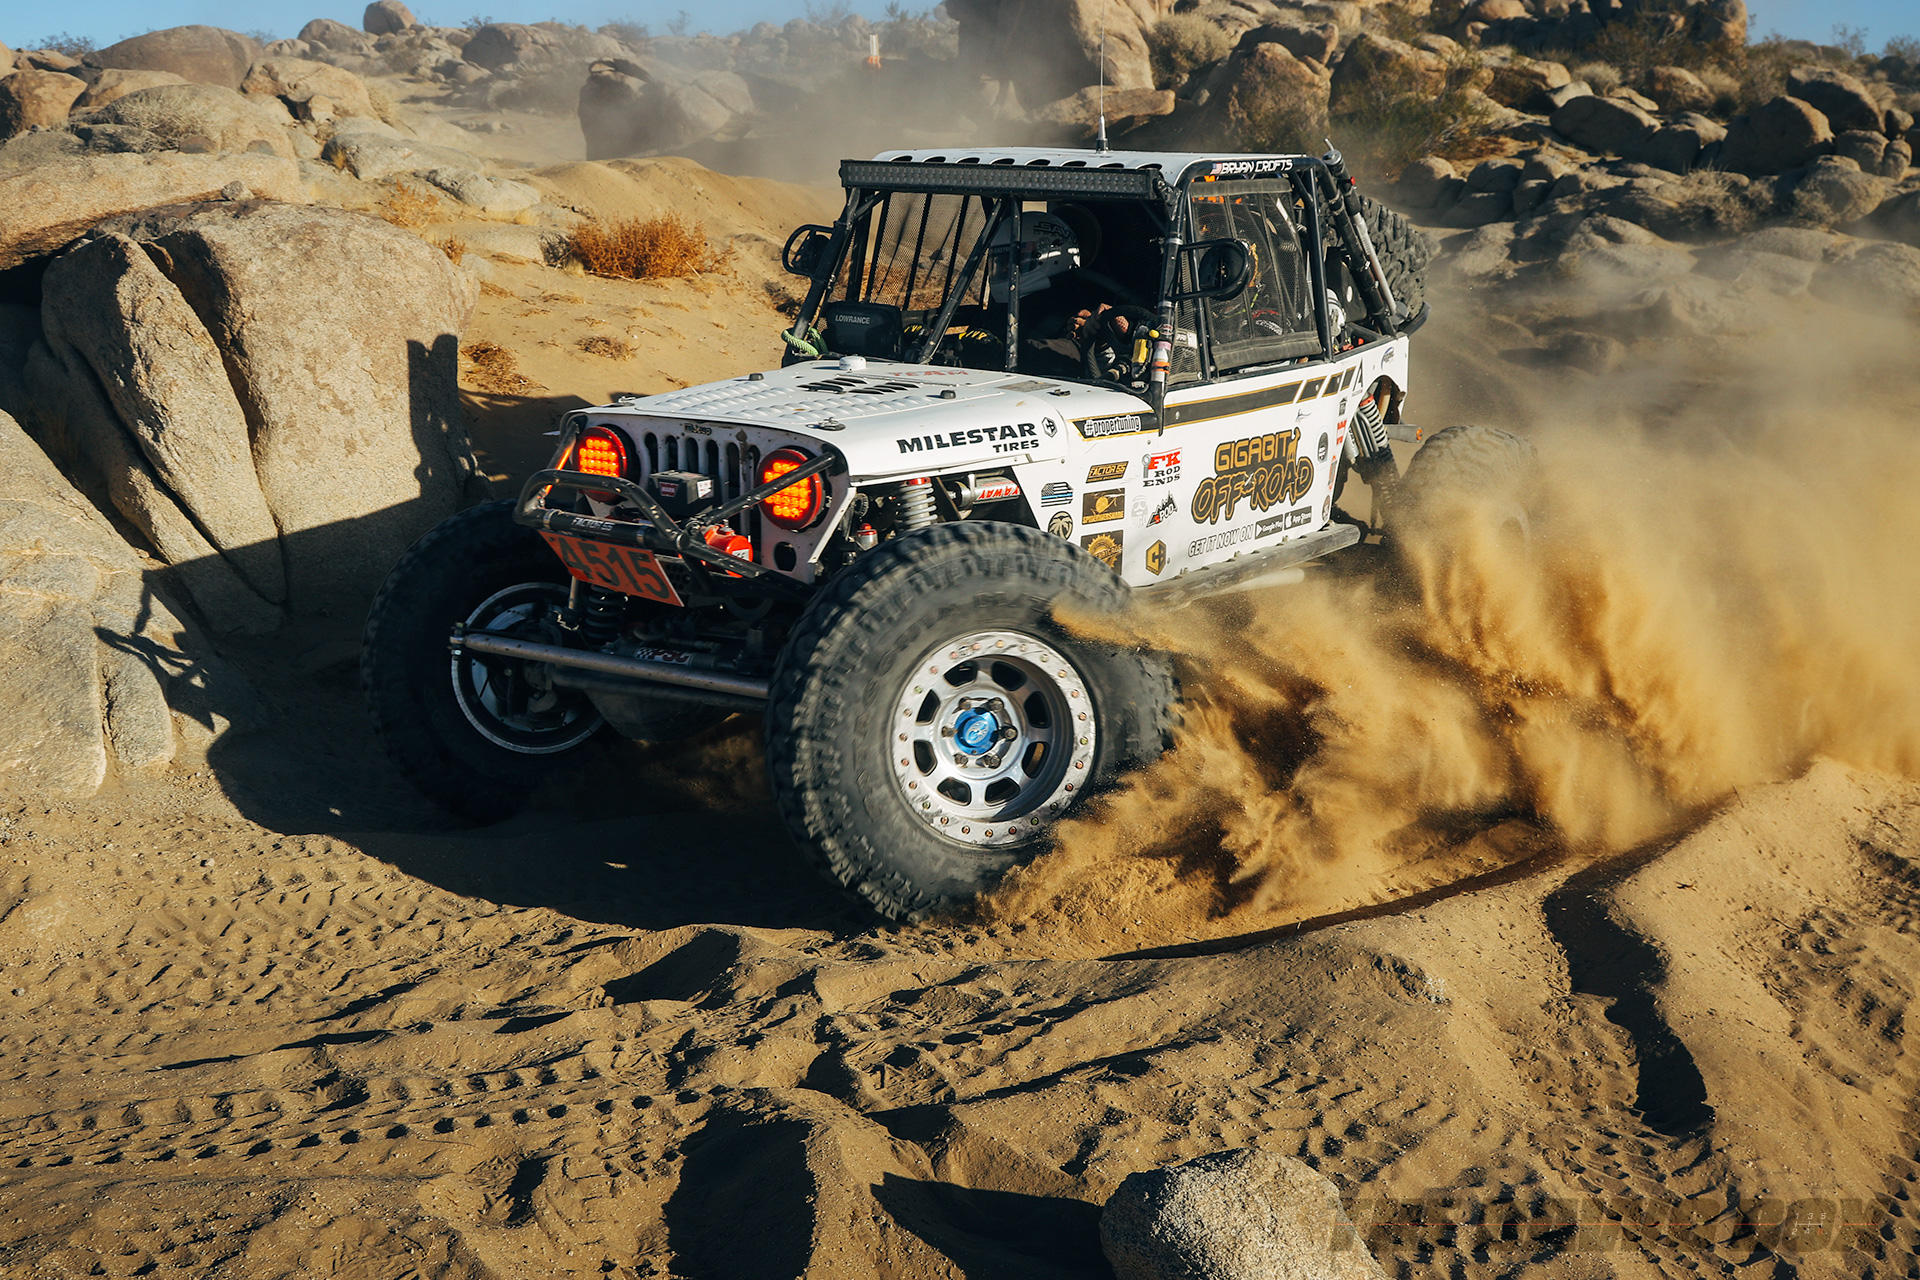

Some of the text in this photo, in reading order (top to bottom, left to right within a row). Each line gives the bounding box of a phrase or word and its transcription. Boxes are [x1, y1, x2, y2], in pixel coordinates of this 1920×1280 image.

[1220, 159, 1293, 174] BRYAN CROFTS
[835, 314, 871, 325] LOWRANCE
[1085, 416, 1141, 435] #propertuning
[896, 422, 1037, 453] MILESTAR
[992, 439, 1040, 453] TIRES
[1215, 430, 1293, 473] GIGABIT
[1147, 451, 1181, 470] FK
[1142, 473, 1181, 487] ENDS
[1154, 465, 1181, 478] ROD
[571, 517, 602, 529] FACTOR
[1188, 538, 1207, 557] GET
[1216, 528, 1241, 550] NOW
[1240, 524, 1254, 543] ON
[557, 537, 671, 599] 4515
